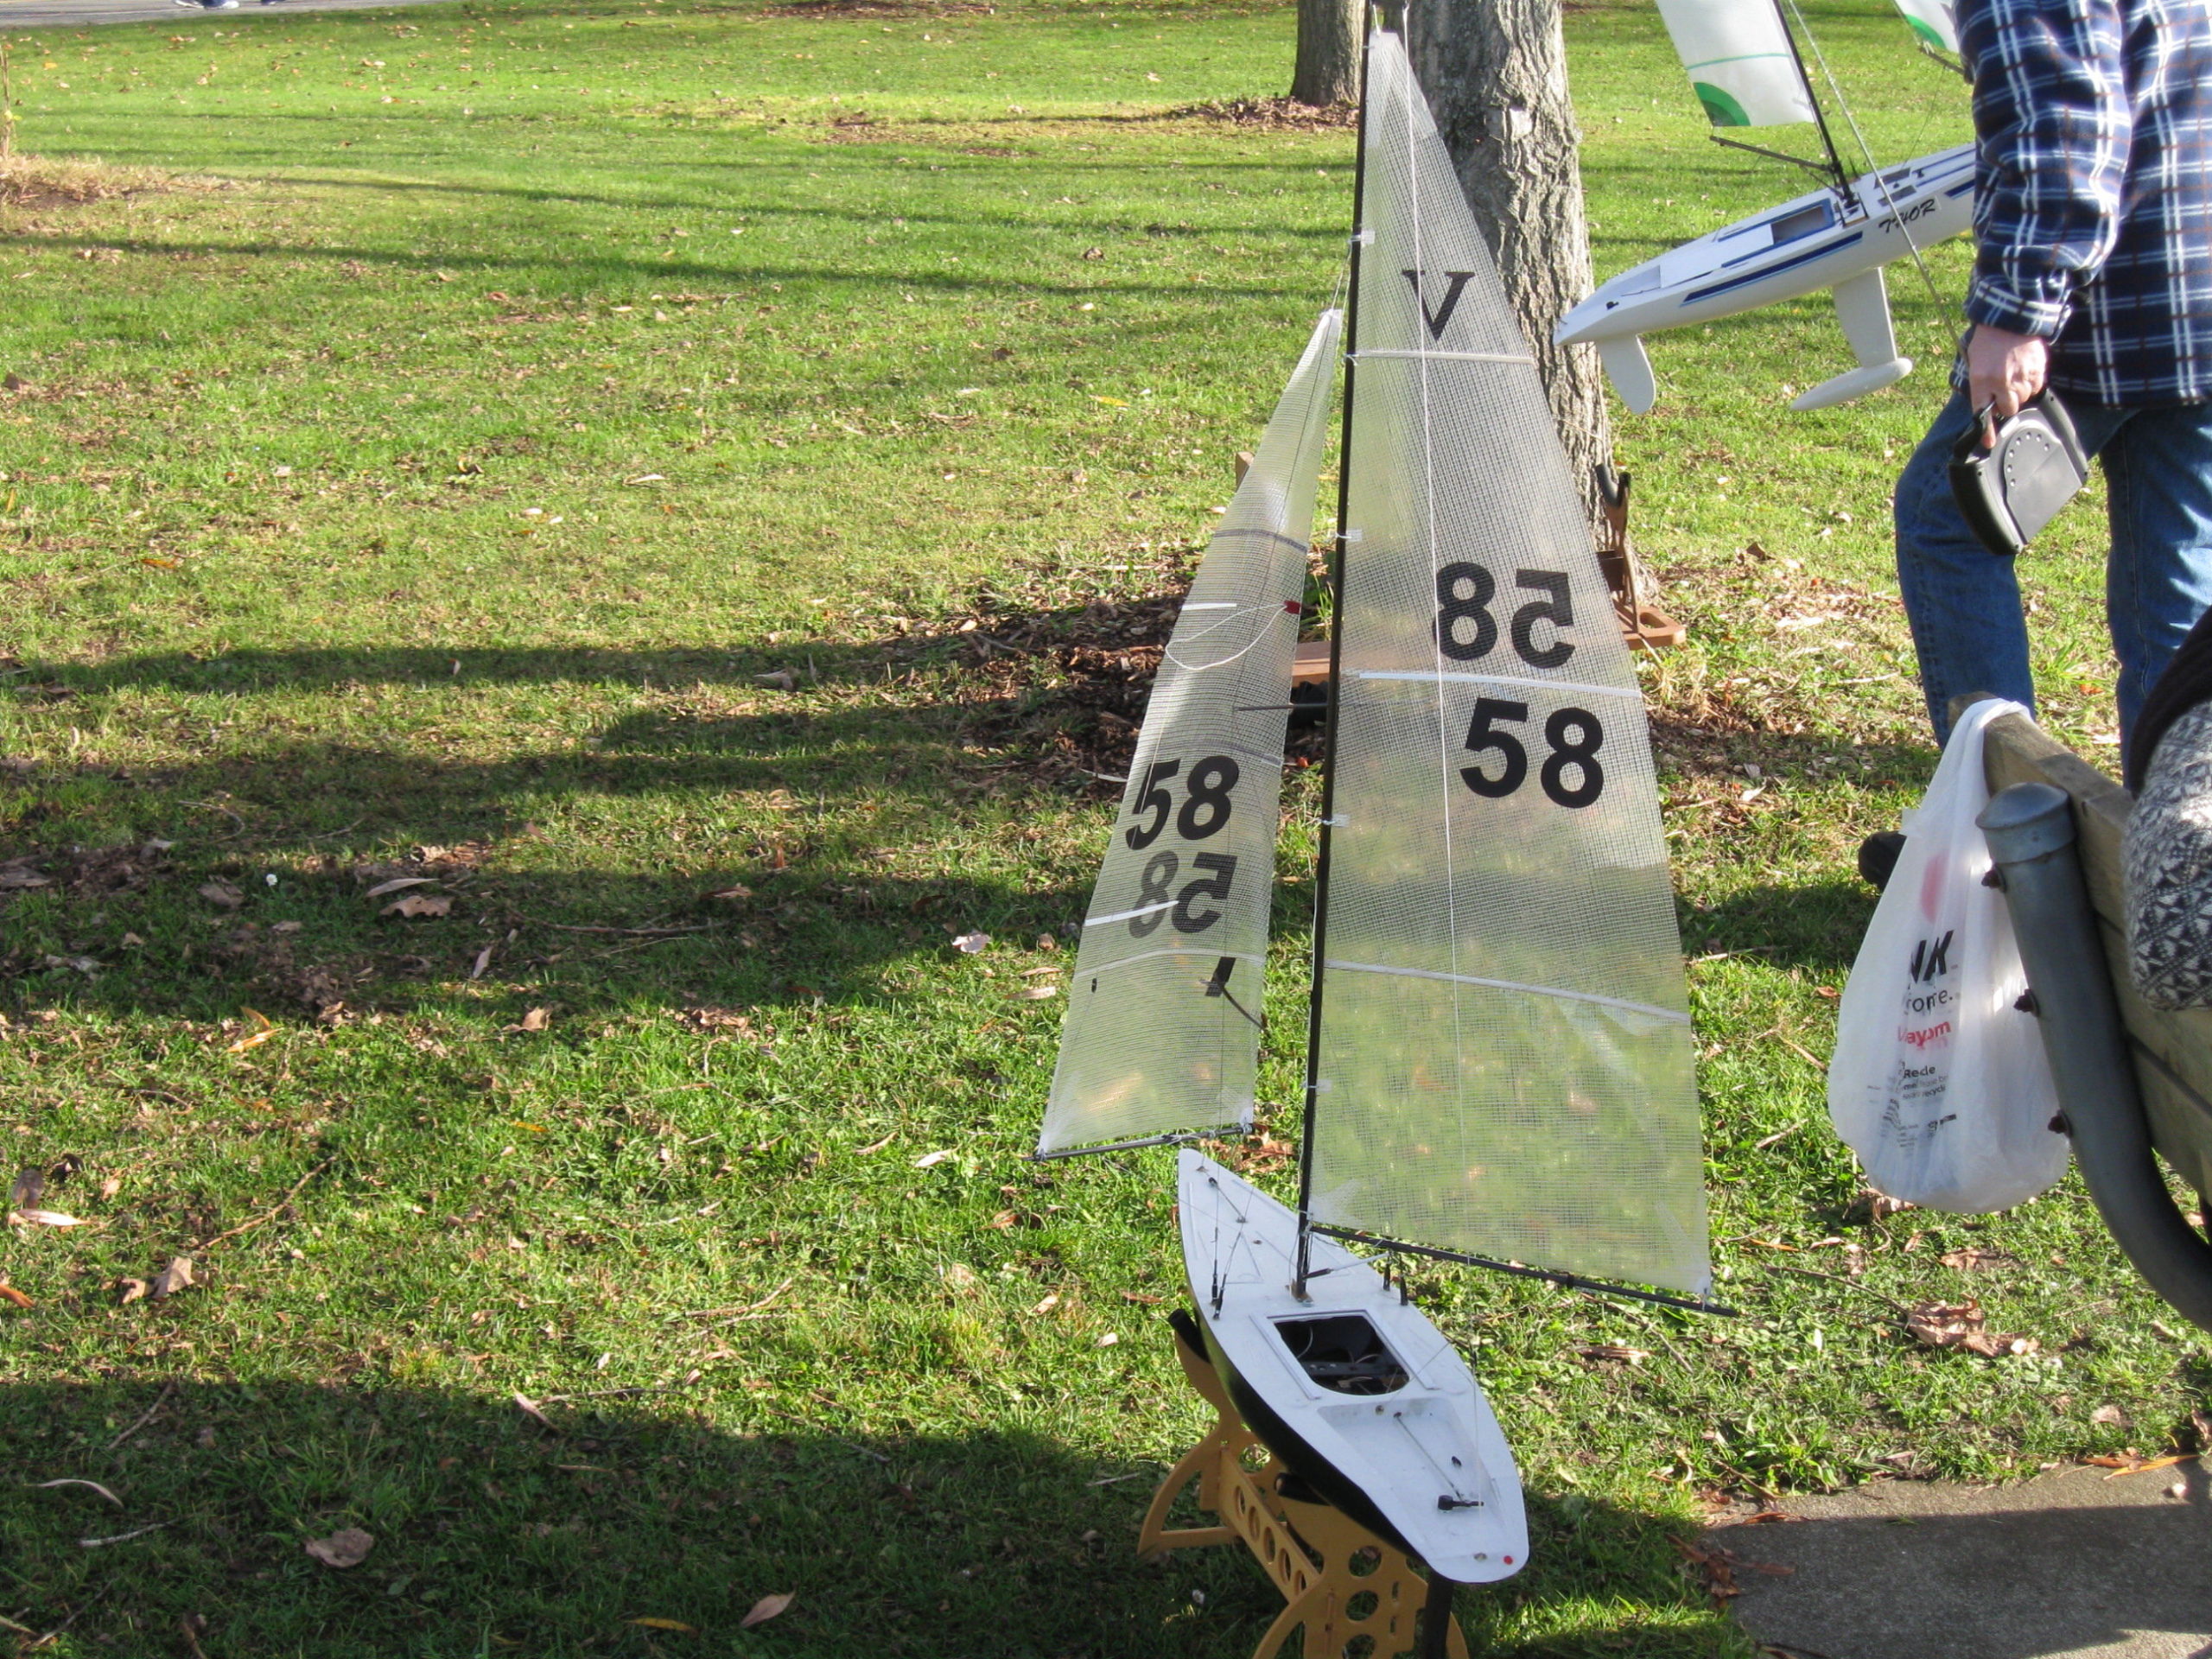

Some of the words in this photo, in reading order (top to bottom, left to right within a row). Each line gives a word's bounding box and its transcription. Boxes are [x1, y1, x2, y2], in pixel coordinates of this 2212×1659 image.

[1878, 199, 1936, 233] THOR
[1402, 270, 1476, 342] V
[1459, 697, 1605, 809] 58
[1126, 755, 1239, 850] 58
